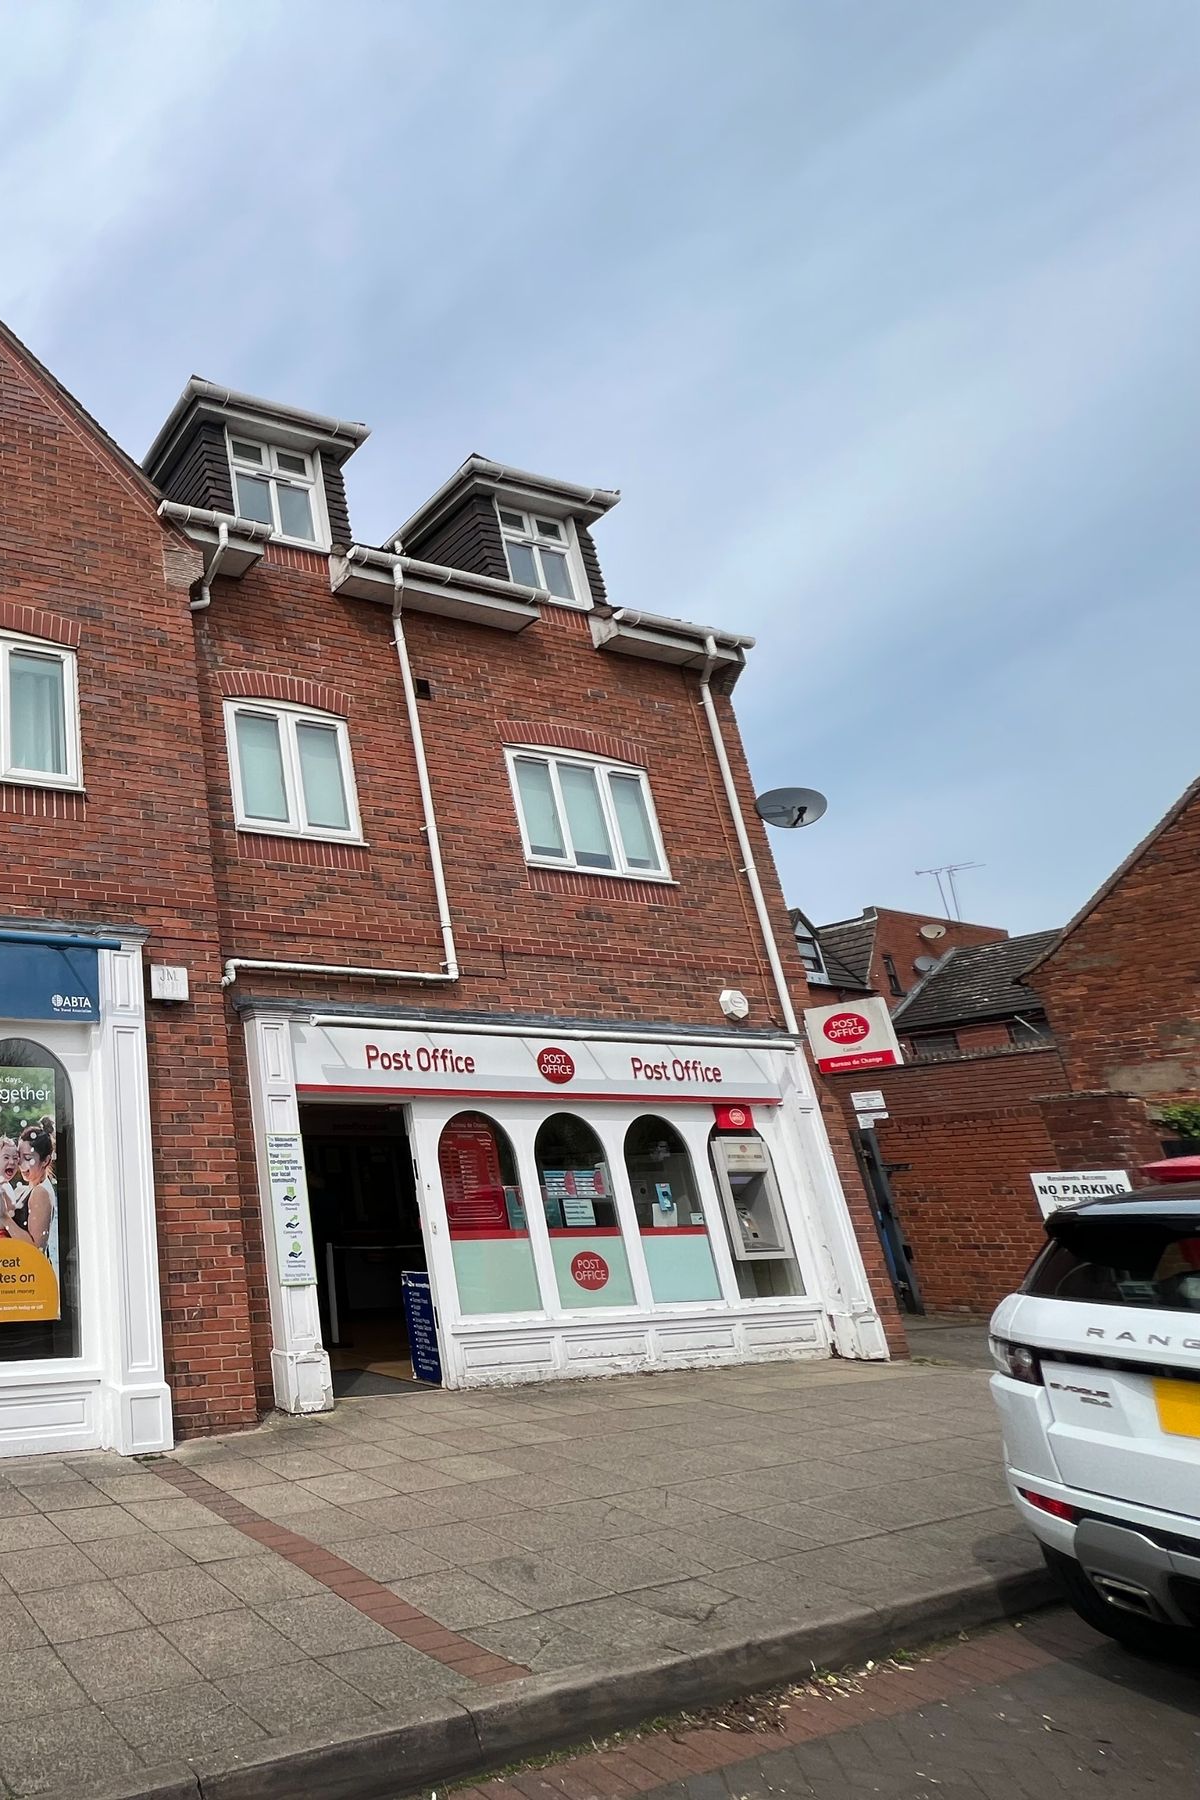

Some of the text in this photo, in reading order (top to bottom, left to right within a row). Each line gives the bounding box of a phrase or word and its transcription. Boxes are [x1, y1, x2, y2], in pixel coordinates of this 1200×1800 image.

[63, 996, 91, 1008] ABTA
[832, 1017, 858, 1029] POST
[828, 1026, 865, 1039] OFFICE
[365, 1044, 476, 1074] Post Office
[543, 1053, 566, 1064] POST
[861, 1056, 883, 1064] Change
[540, 1064, 572, 1076] OFFICE
[631, 1057, 723, 1083] Post Office
[1039, 1184, 1126, 1194] NO PARKING
[577, 1260, 599, 1269] POST
[20, 1274, 35, 1282] on
[575, 1271, 607, 1281] OFFICE
